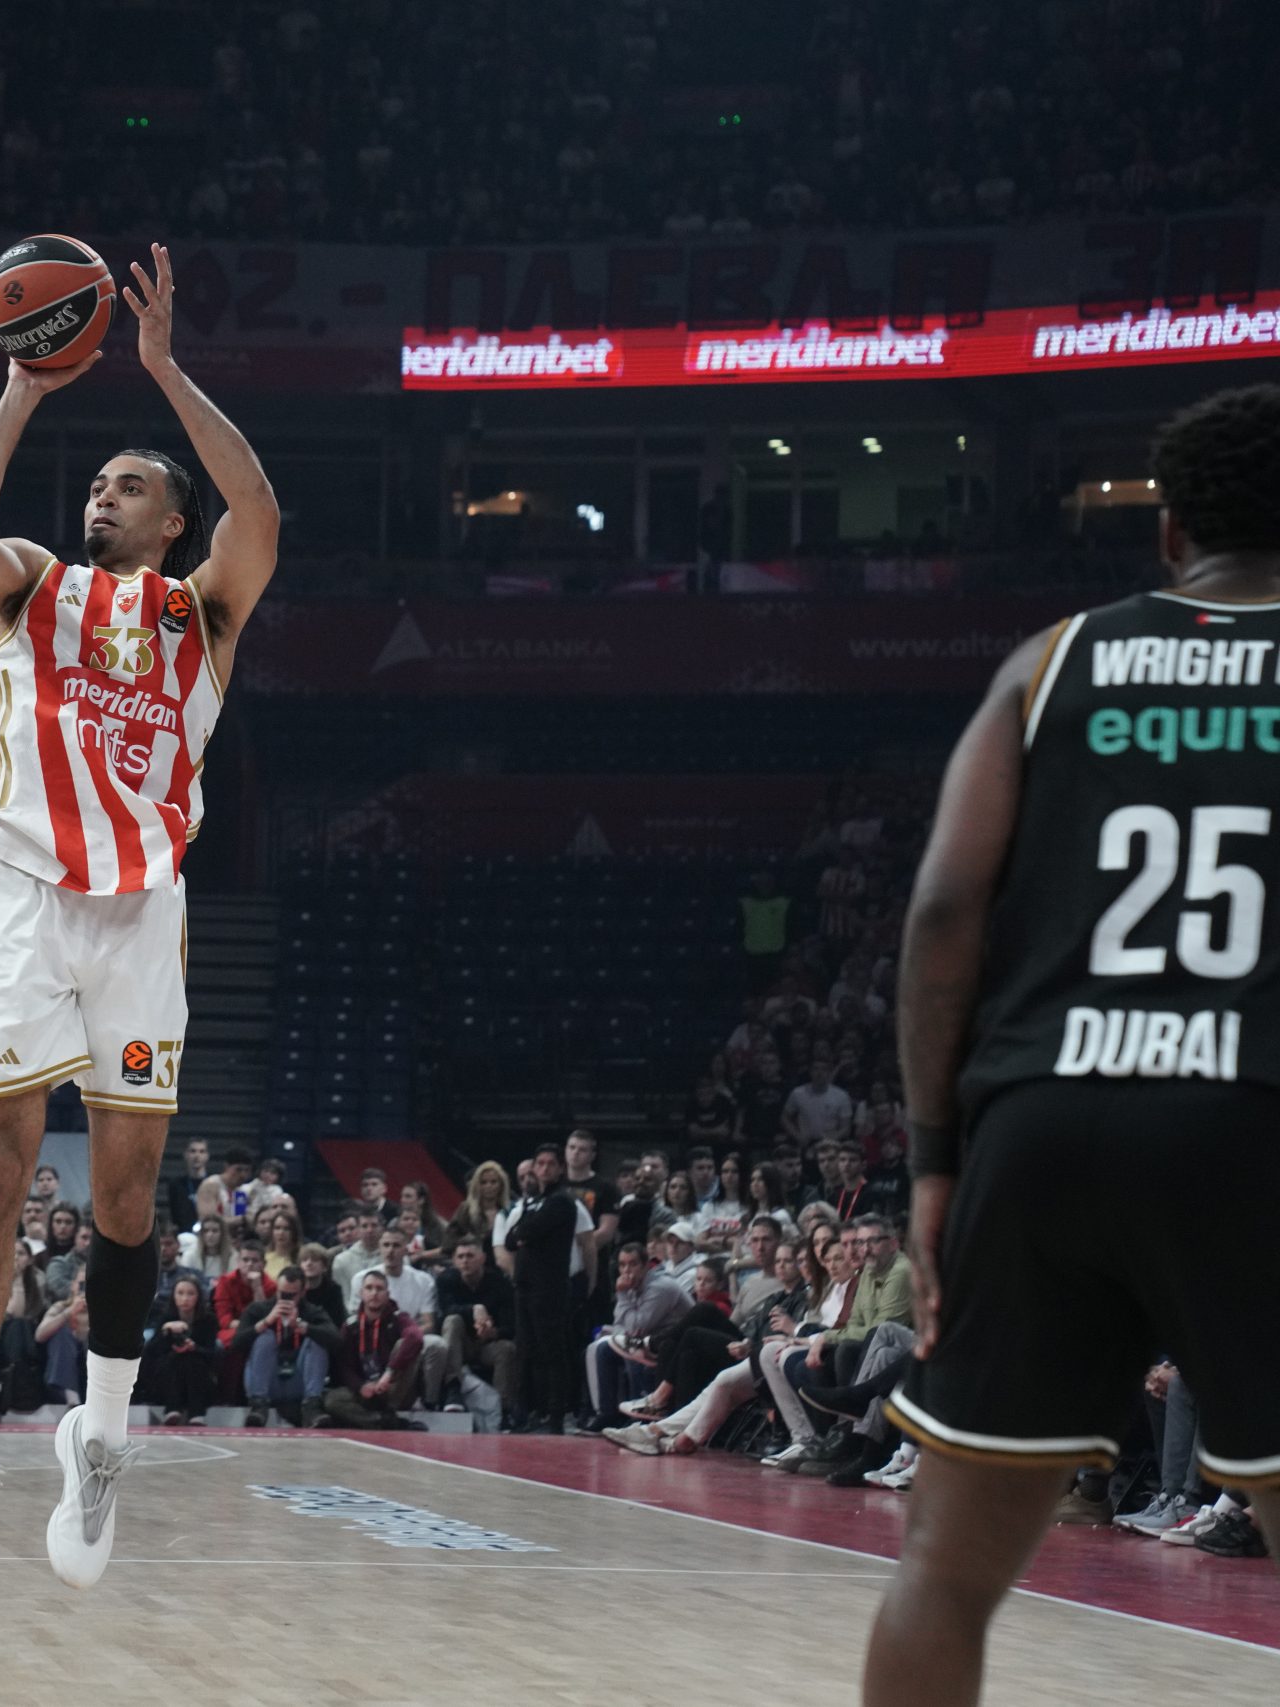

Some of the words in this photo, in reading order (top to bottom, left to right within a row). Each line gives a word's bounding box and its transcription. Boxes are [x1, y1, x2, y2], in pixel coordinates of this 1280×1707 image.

[695, 322, 951, 372] meridianbet
[89, 625, 157, 676] 33
[1091, 636, 1275, 687] WRIGHT
[63, 677, 177, 730] meridian
[78, 719, 151, 774] mts
[1088, 804, 1272, 980] 25
[1053, 1006, 1242, 1082] DUBAI
